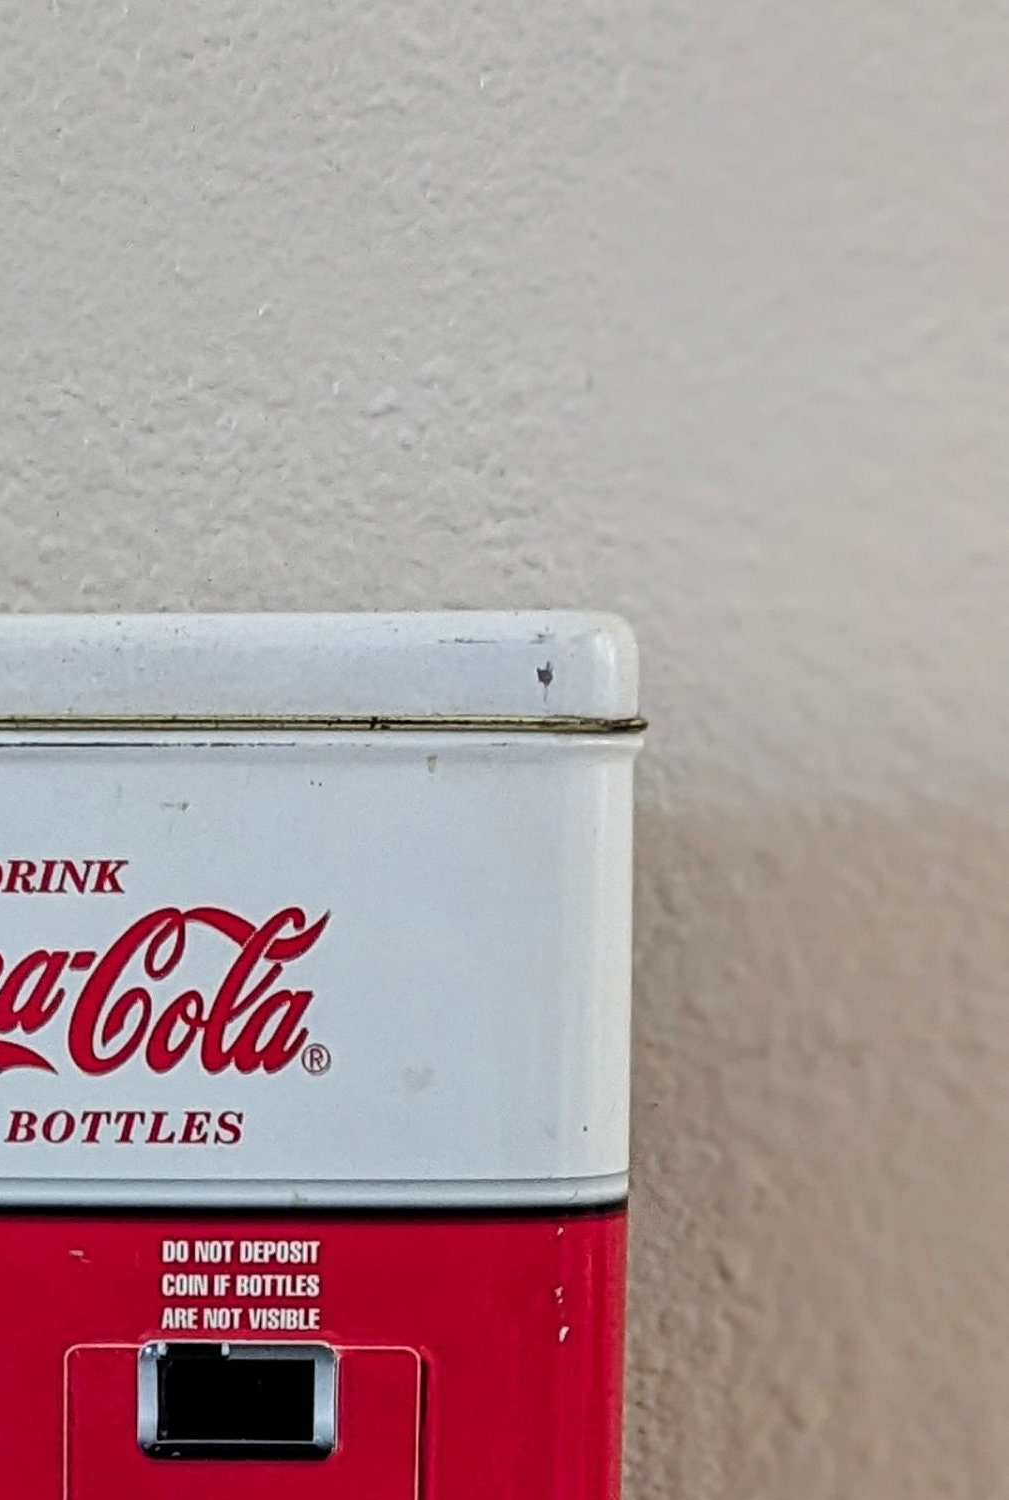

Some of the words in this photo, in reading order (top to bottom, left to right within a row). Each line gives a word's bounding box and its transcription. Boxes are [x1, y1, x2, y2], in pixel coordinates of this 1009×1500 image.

[4, 1110, 244, 1144] BOTTLES
[162, 1240, 189, 1263] DO
[194, 1240, 234, 1263] NOT
[239, 1240, 320, 1264] DEPOSIT
[161, 1274, 209, 1297] COIN
[213, 1274, 231, 1297] IF
[235, 1274, 320, 1297] BOTTLES
[161, 1307, 198, 1330] ARE
[203, 1307, 242, 1330] NOT
[248, 1307, 320, 1330] VISIBLE
